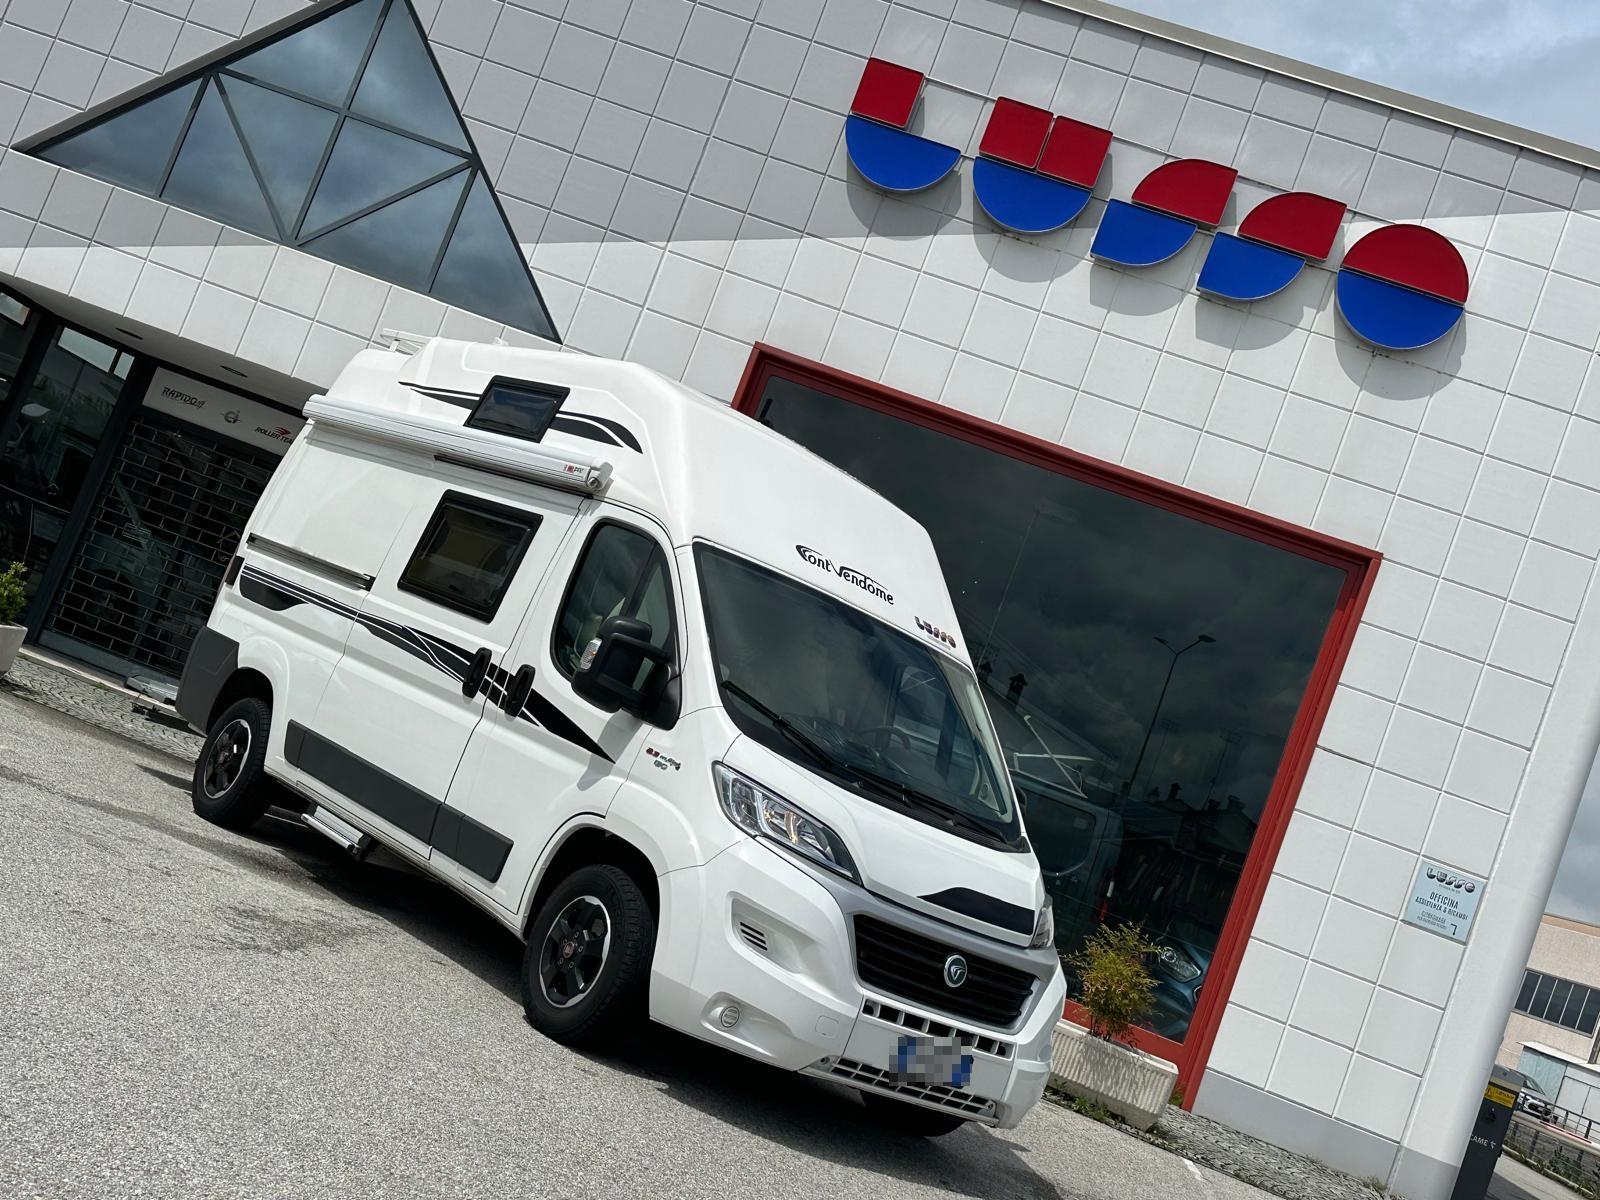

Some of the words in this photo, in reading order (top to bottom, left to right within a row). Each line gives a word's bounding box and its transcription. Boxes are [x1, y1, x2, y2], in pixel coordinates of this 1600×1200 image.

[254, 426, 281, 440] ROLLER
[280, 434, 294, 445] TEA
[1429, 891, 1459, 910] OFFICINA
